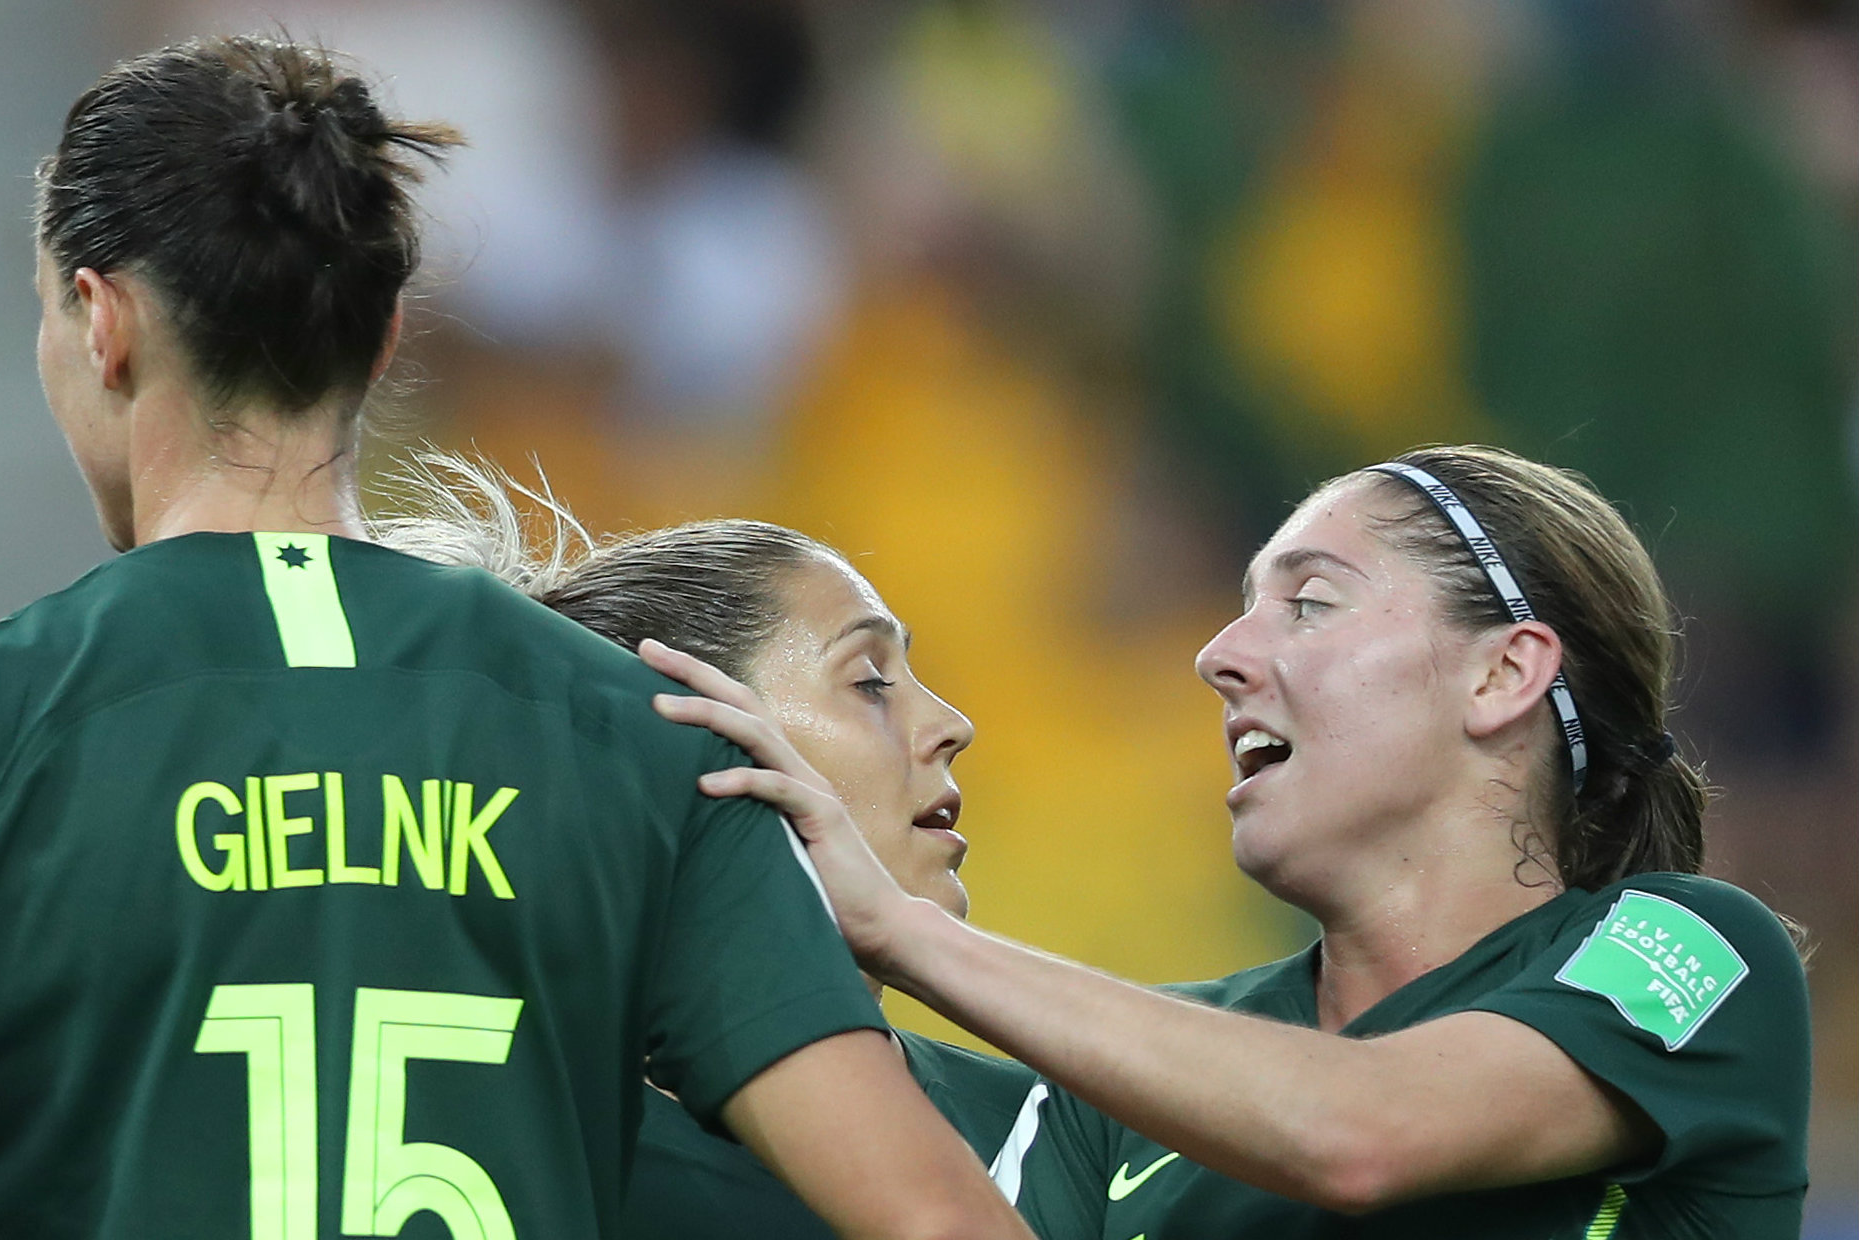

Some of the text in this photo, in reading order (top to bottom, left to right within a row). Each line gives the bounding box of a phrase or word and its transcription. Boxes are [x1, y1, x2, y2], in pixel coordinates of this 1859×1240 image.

[1425, 484, 1461, 508] NIKE
[1468, 537, 1505, 568] NIKE
[1506, 597, 1535, 622] NIK
[1564, 718, 1584, 743] NIKE
[175, 771, 520, 899] GIELNK
[1646, 978, 1690, 1024] FIFA
